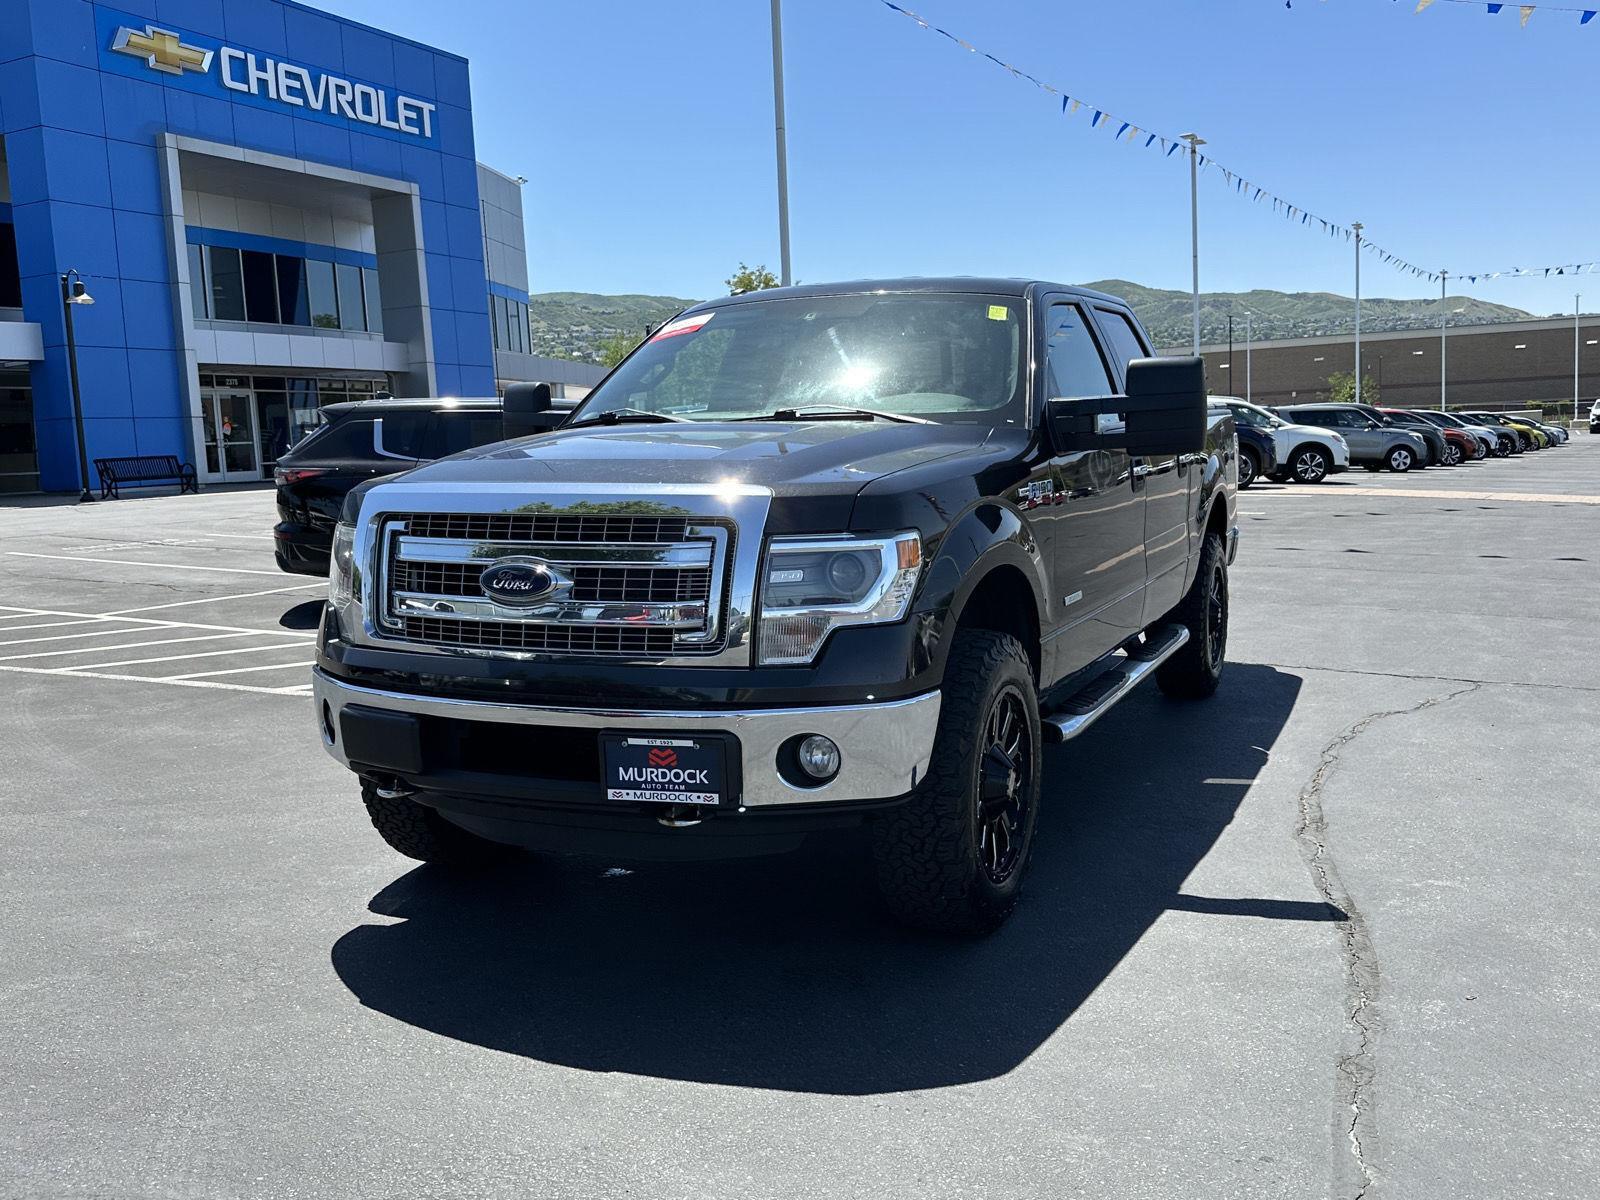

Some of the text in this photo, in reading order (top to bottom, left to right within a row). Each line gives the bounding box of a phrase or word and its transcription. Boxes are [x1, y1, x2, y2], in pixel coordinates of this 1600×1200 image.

[220, 46, 436, 138] CHEVROLET
[492, 569, 534, 590] Ford
[618, 767, 709, 784] MURDOCK
[633, 791, 694, 802] MURDOCK
